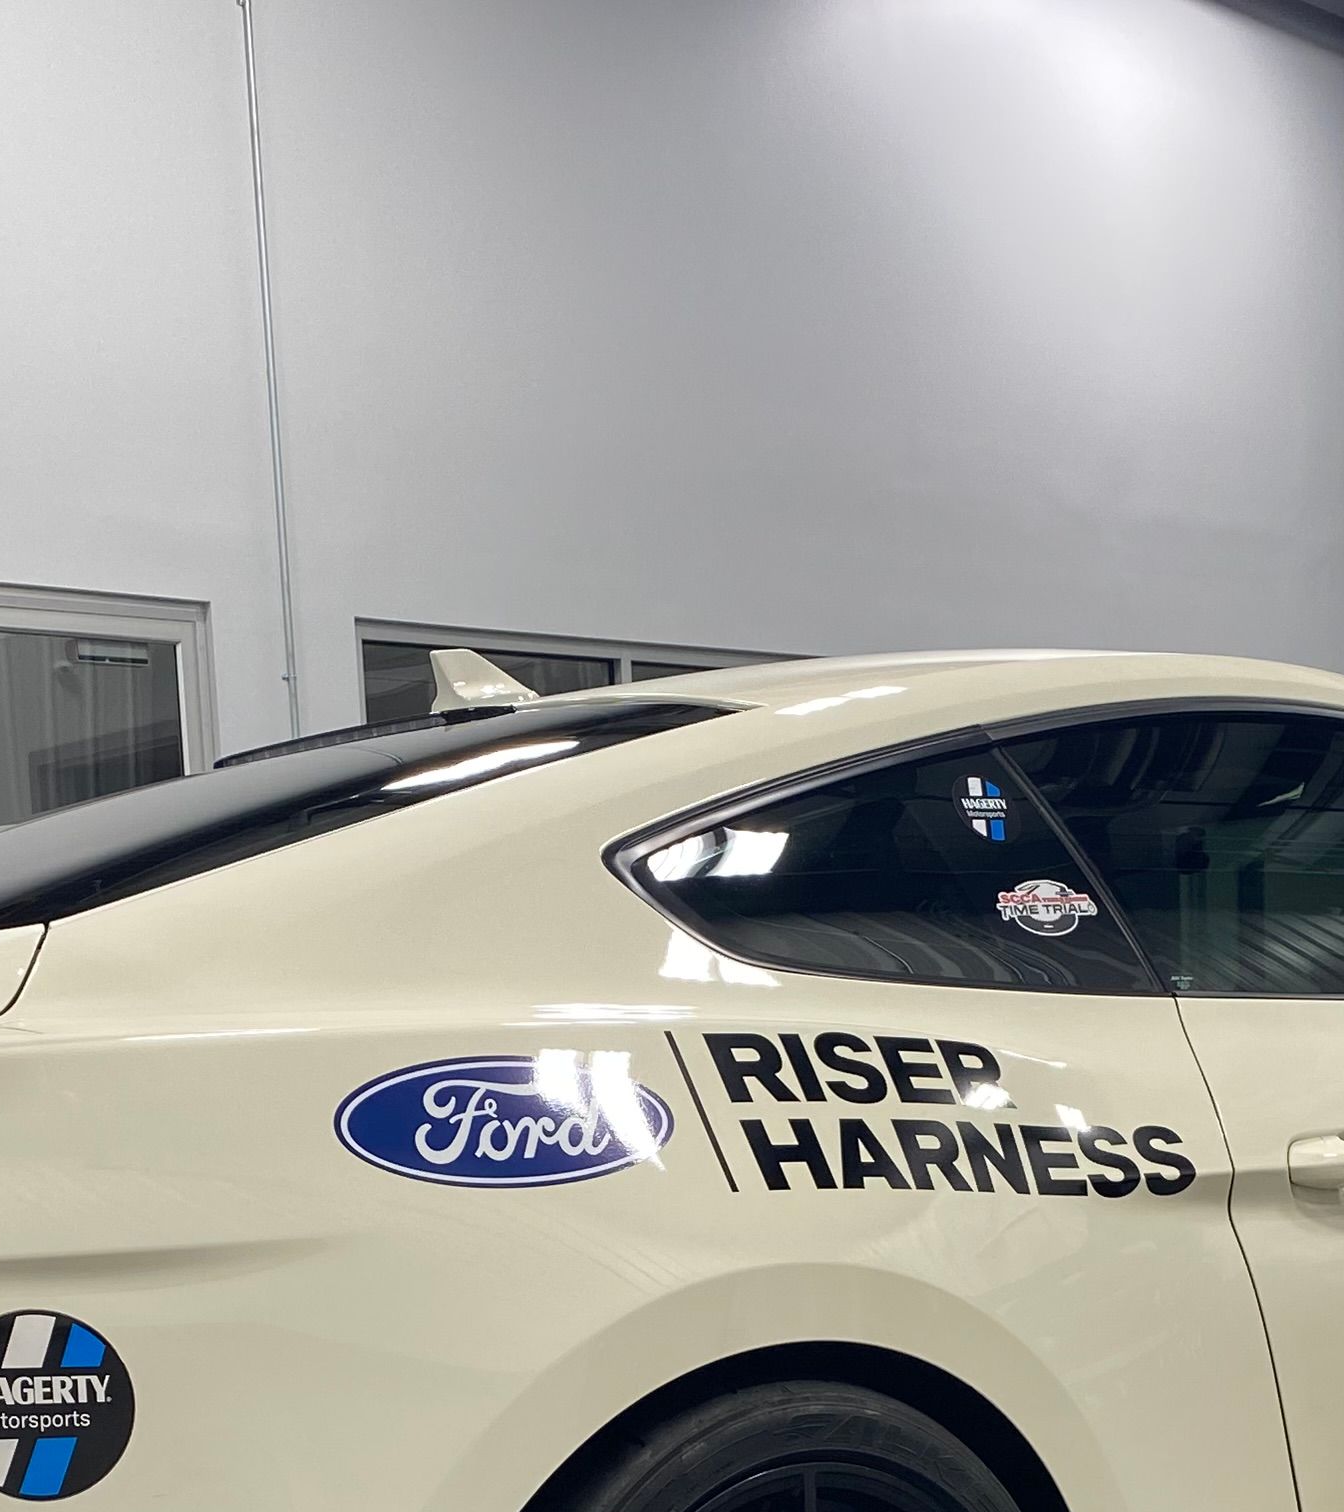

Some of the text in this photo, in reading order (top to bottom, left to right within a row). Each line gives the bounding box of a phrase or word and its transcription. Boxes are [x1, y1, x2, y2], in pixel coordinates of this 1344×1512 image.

[961, 798, 1007, 810] HAGERTY
[999, 904, 1039, 918] TIME
[1000, 893, 1041, 904] SCCA
[702, 1032, 1017, 1109] RISER
[415, 1079, 613, 1165] Ford
[740, 1118, 1197, 1198] HARNESS
